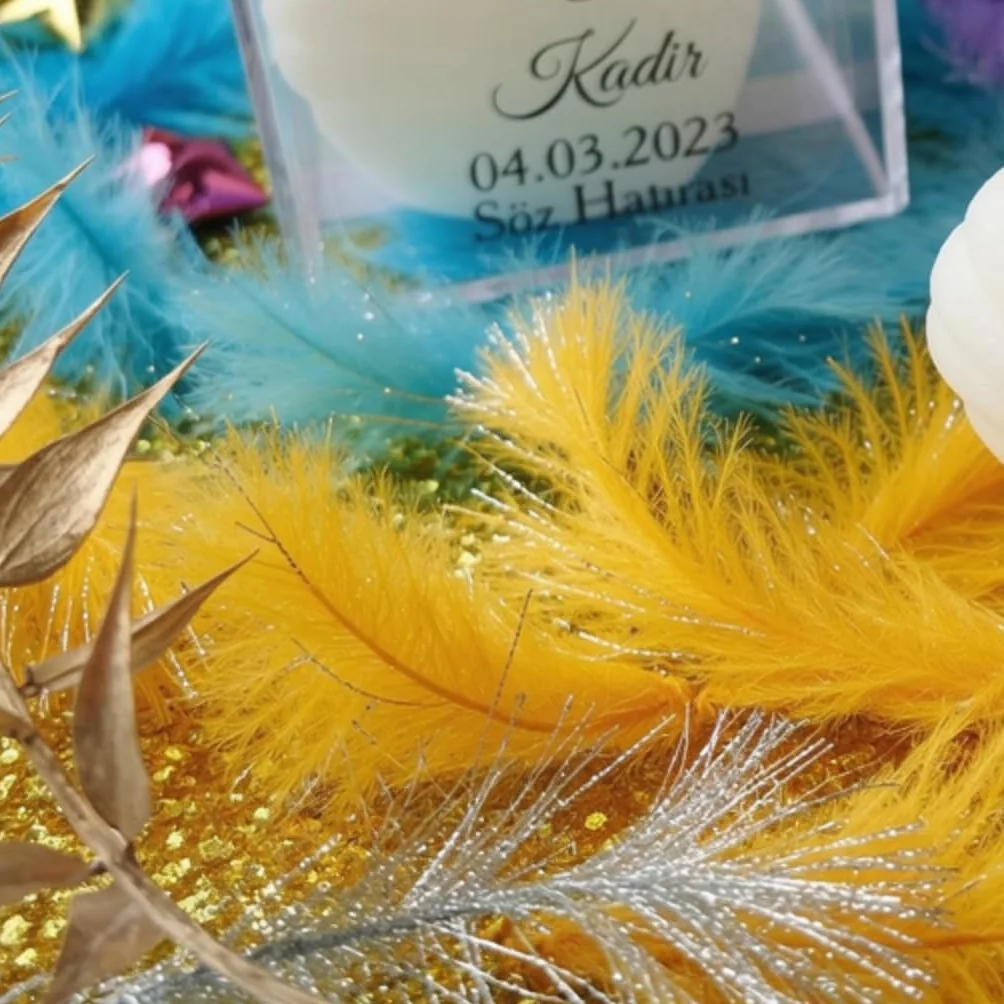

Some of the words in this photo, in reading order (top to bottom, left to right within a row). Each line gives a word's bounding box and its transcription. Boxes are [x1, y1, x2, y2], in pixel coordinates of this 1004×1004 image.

[492, 18, 707, 120] Kadir
[470, 112, 739, 193] 04.03.2023
[473, 200, 556, 242] Söz
